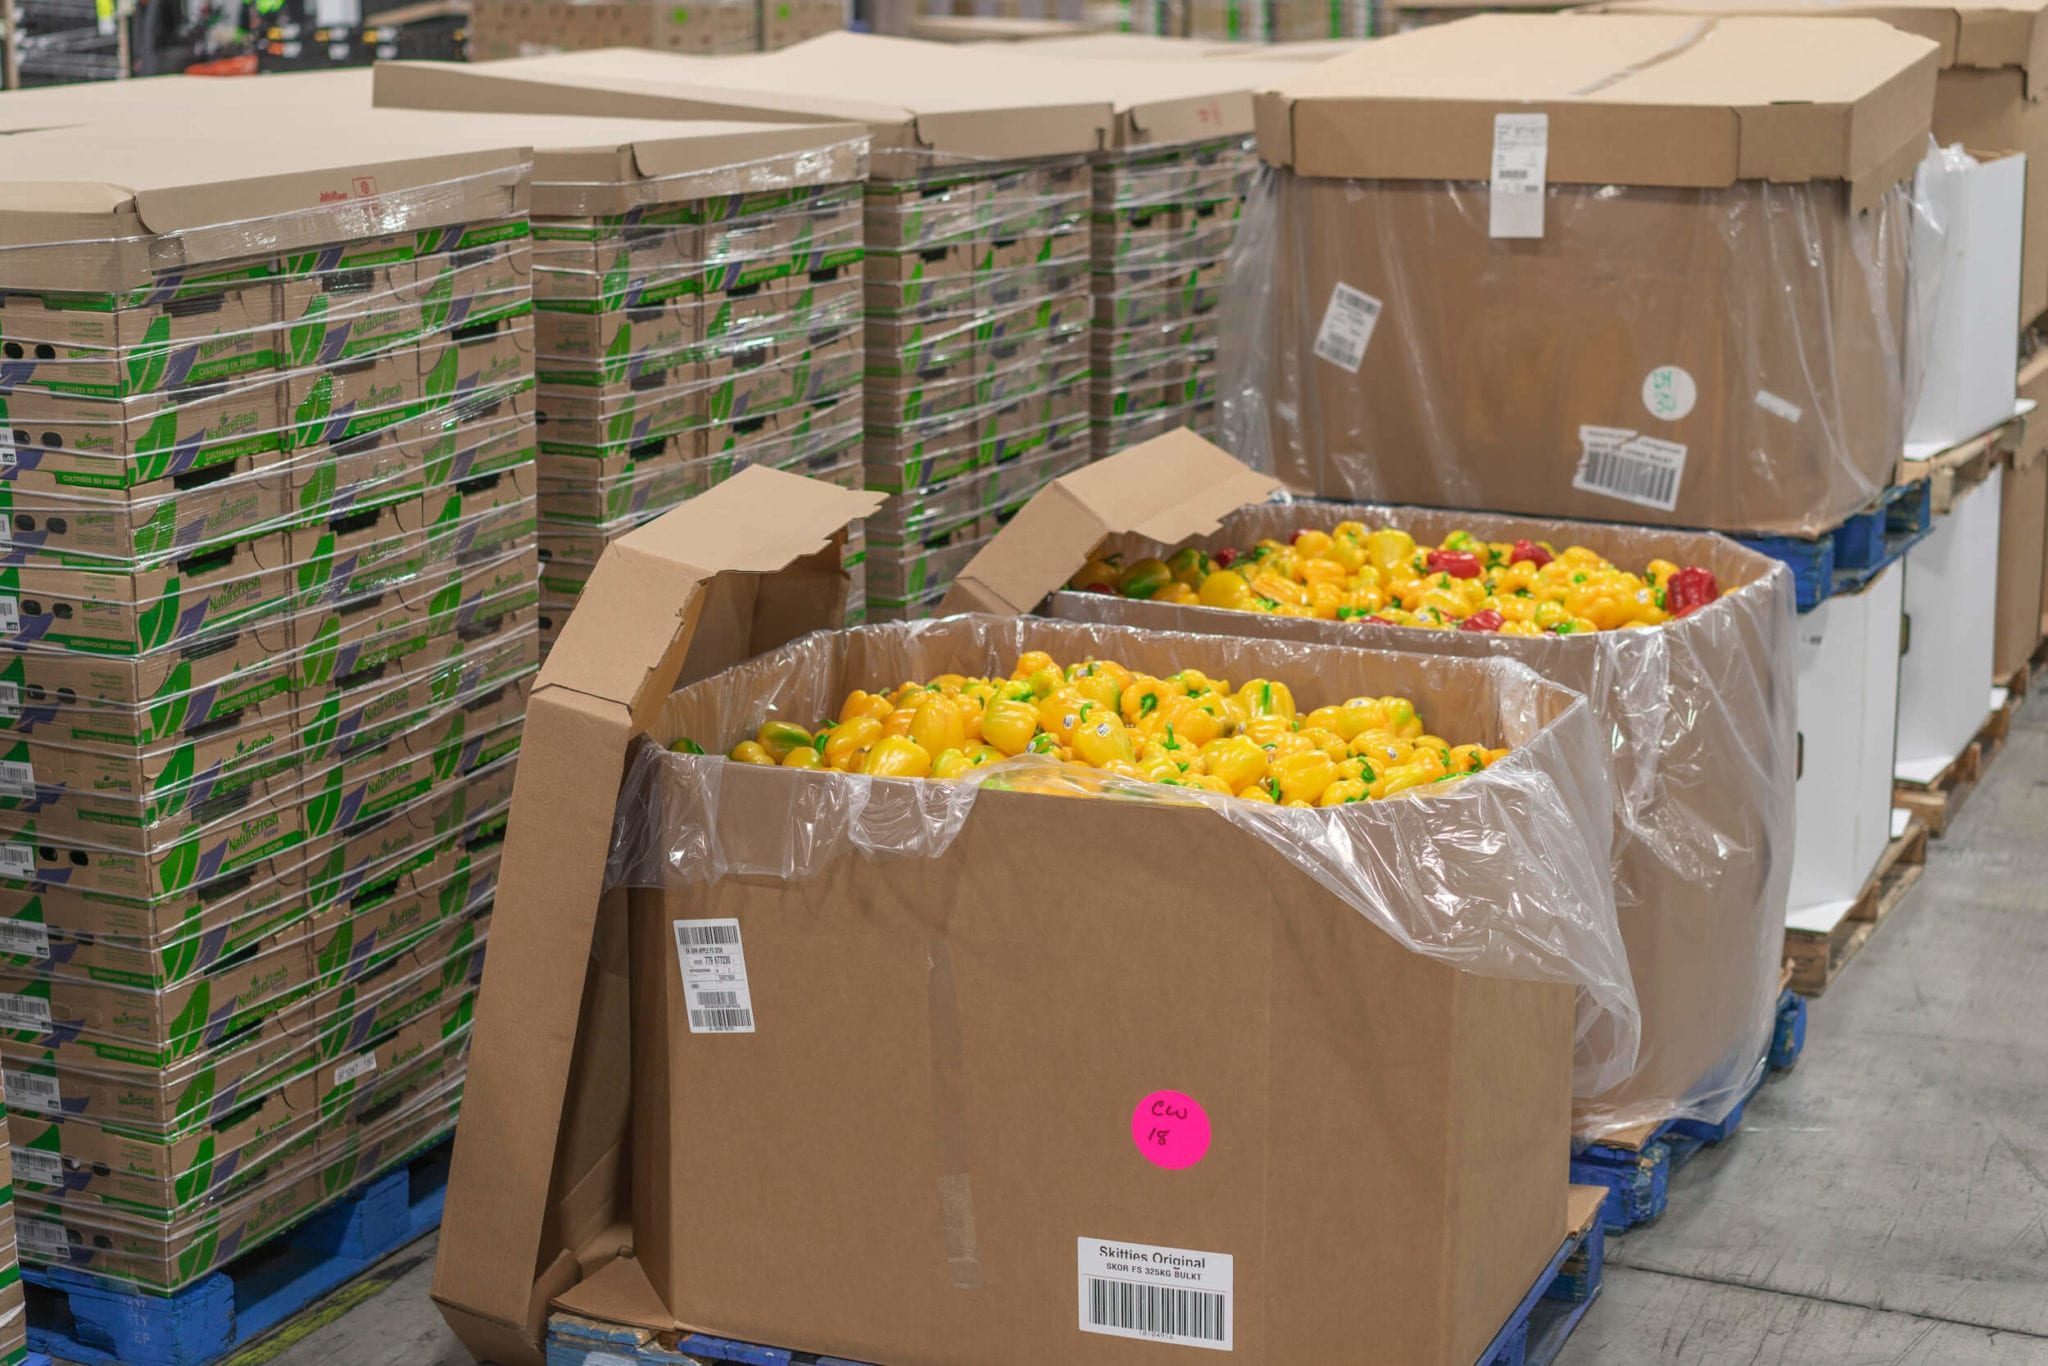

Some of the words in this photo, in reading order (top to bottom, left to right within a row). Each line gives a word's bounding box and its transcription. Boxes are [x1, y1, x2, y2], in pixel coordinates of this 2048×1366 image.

[1148, 1127, 1170, 1146] 18
[1106, 1262, 1129, 1272] SKOR
[1131, 1265, 1142, 1274] FS
[1144, 1267, 1171, 1278] 325KG
[1152, 1252, 1206, 1270] Original
